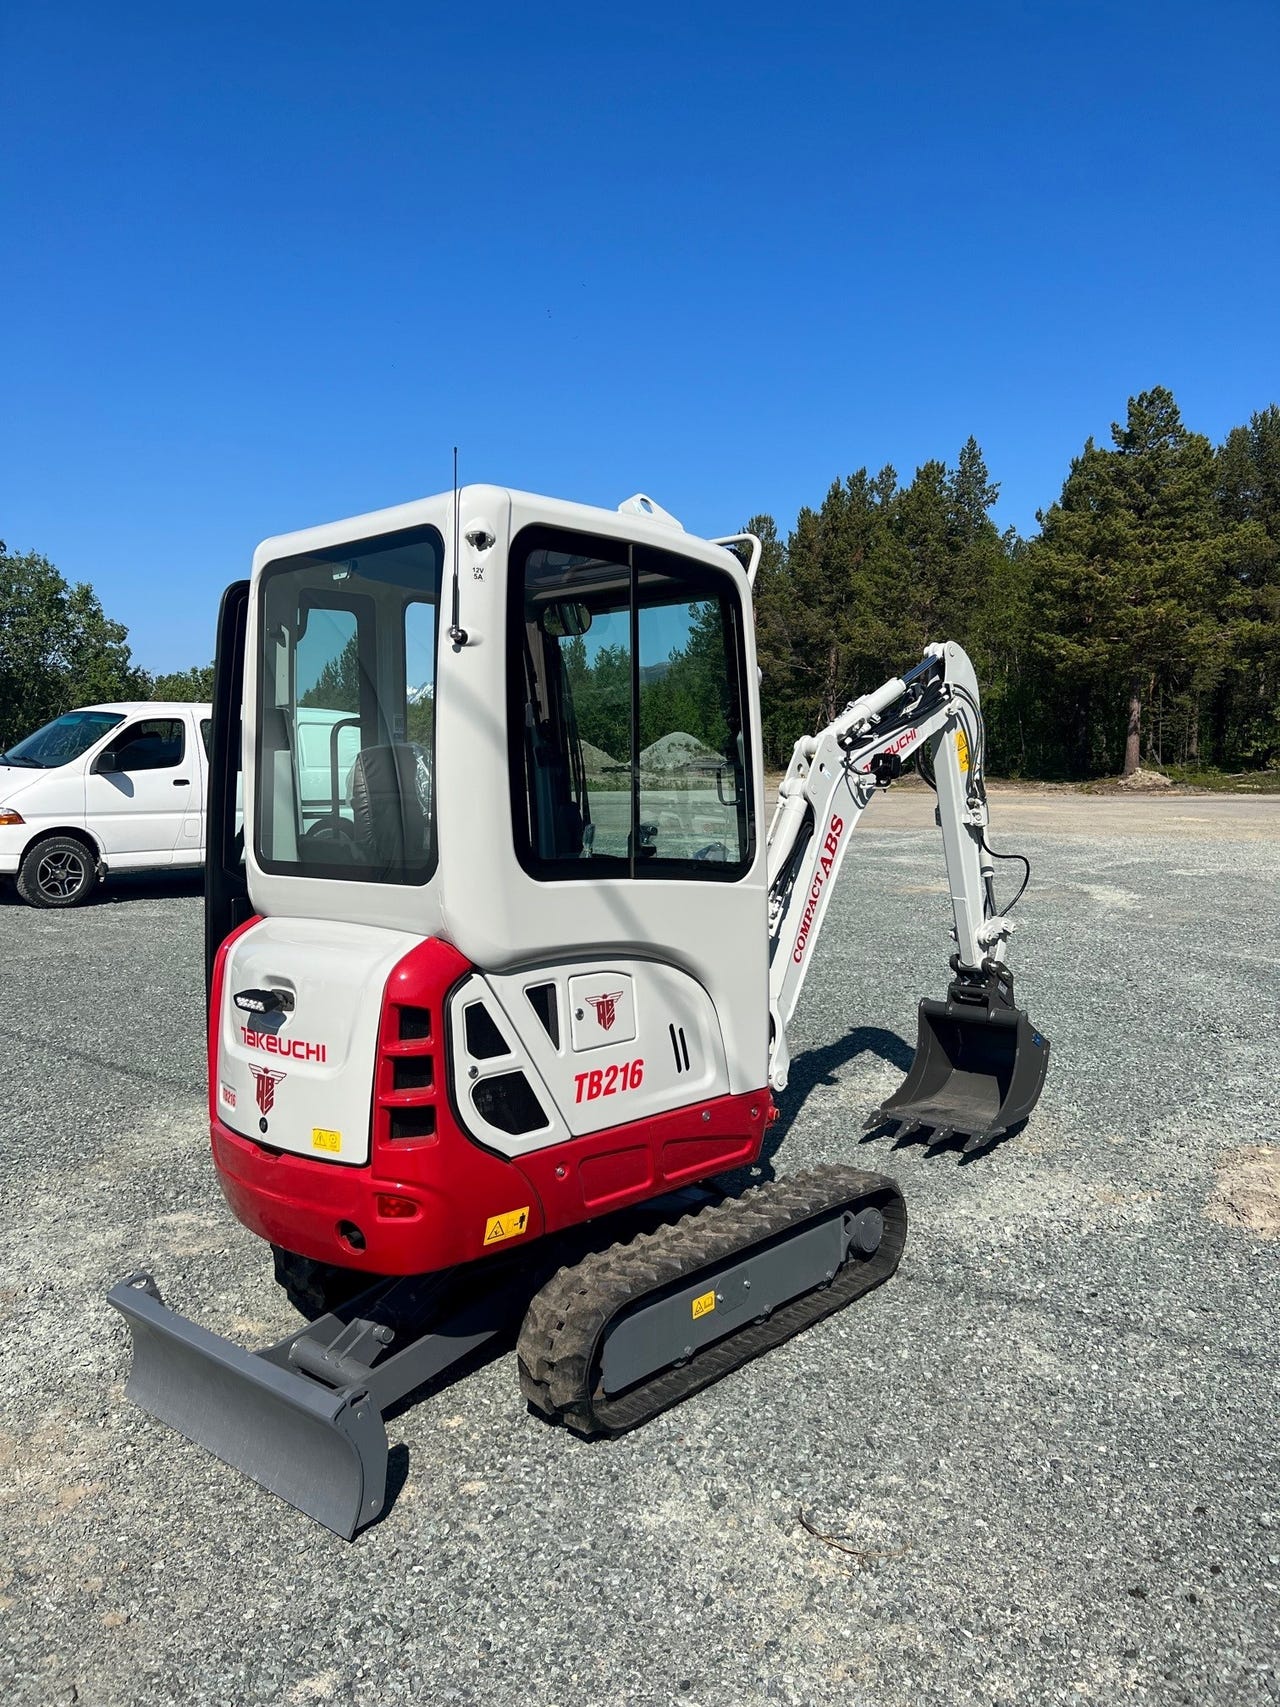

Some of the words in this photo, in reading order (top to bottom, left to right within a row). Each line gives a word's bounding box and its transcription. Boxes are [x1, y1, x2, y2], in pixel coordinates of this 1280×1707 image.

[793, 872, 824, 963] COMPACT
[819, 813, 844, 879] ABS
[574, 1058, 645, 1104] TB216
